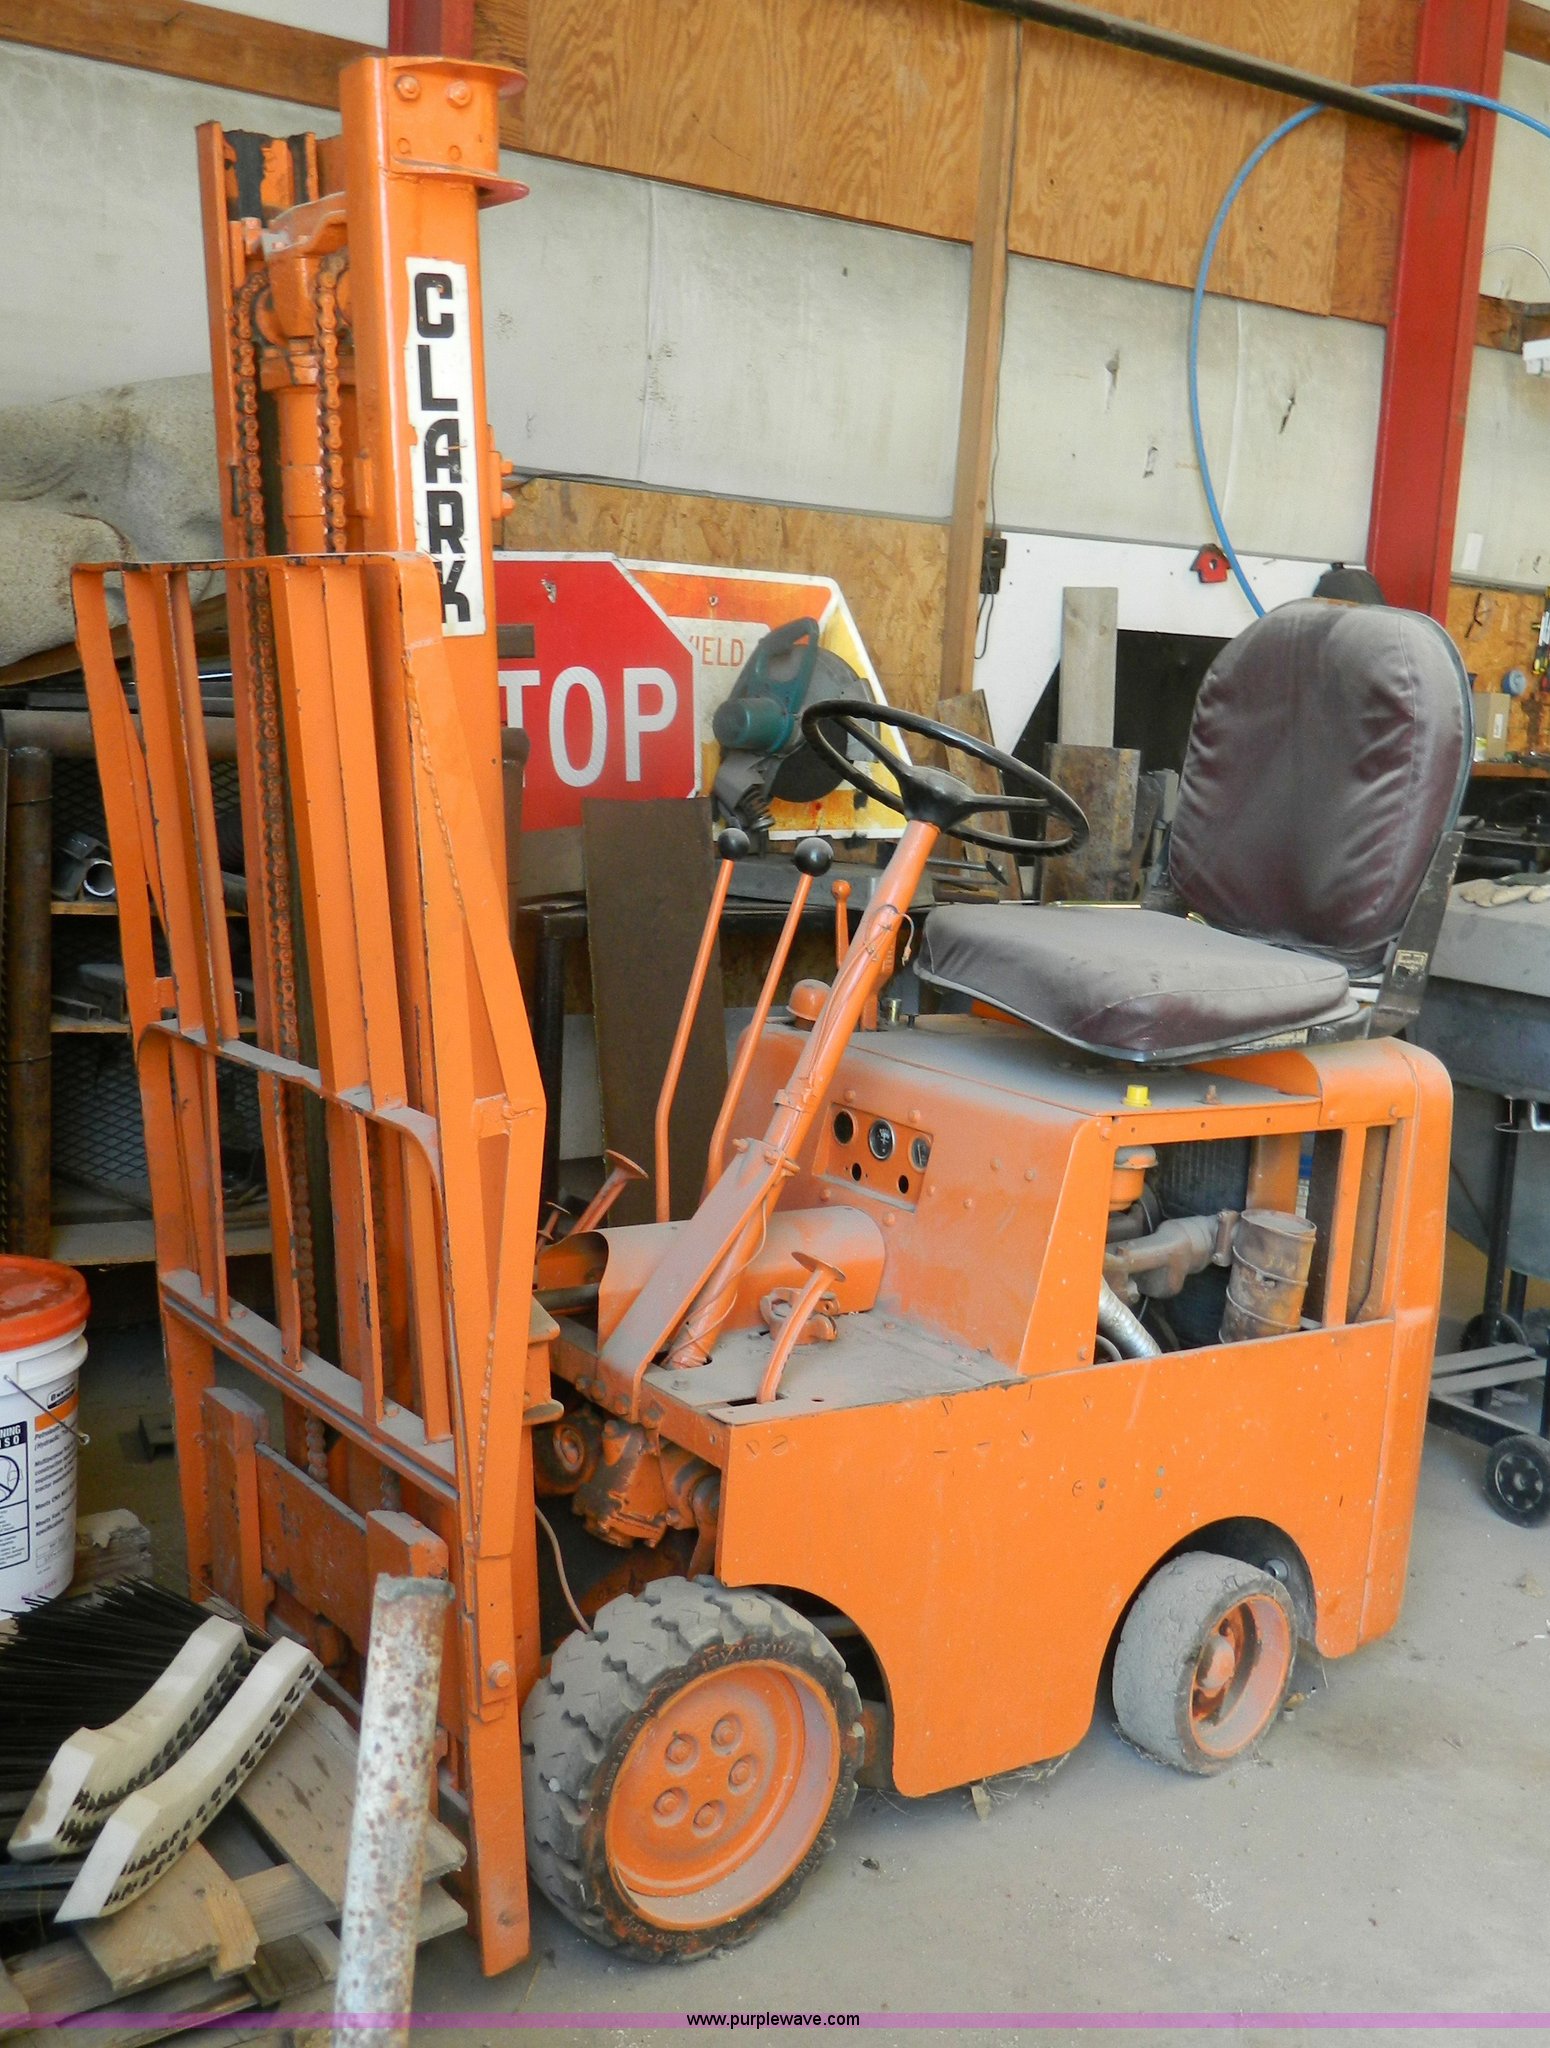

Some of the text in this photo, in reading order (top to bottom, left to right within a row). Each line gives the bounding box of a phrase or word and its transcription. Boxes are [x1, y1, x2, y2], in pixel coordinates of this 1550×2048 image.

[414, 272, 471, 623] CLARK
[689, 635, 745, 667] IELD
[497, 666, 678, 788] TOP
